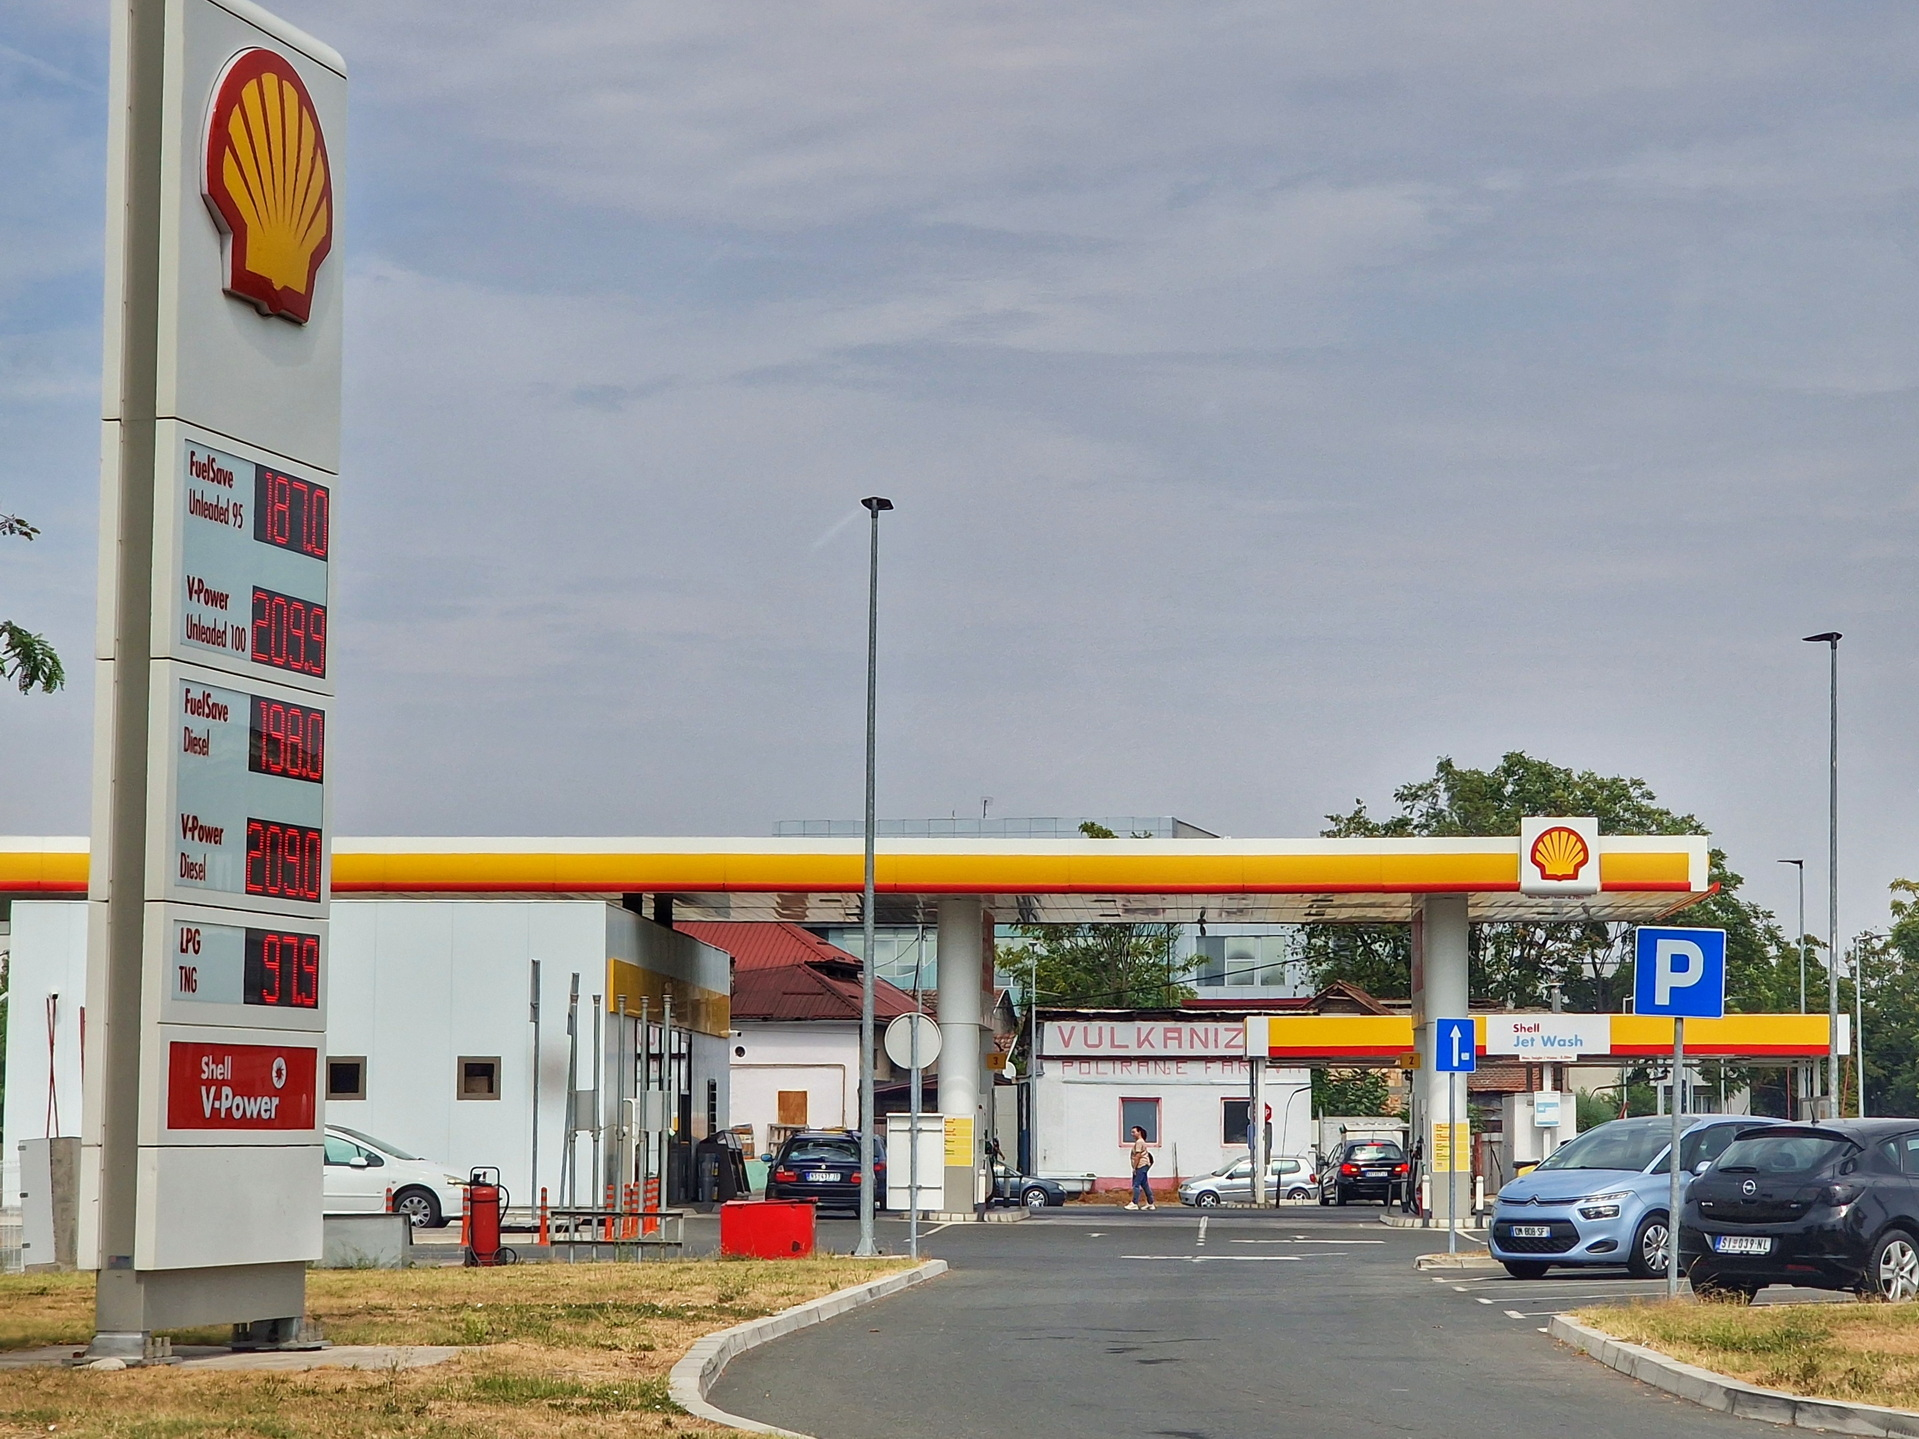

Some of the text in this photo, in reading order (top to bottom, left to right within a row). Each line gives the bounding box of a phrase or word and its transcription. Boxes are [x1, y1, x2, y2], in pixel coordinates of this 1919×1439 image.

[190, 450, 233, 488] FuelSave
[189, 488, 243, 529] Unleaded 95
[265, 472, 327, 556] 187.0
[186, 574, 229, 611] V-Power
[186, 613, 246, 653] Unleaded 100
[252, 591, 325, 674] 209.9
[184, 688, 229, 722] FuelSave
[183, 726, 210, 756] Diesel
[260, 701, 324, 780] 198.0
[181, 813, 224, 846] V-Power
[179, 852, 206, 881] Diesel
[246, 822, 321, 899] 209.0
[179, 927, 201, 955] LPG
[178, 966, 197, 993] TNG
[263, 934, 318, 1006] 97.9
[1654, 938, 1704, 1006] P
[1513, 1023, 1540, 1033] Shell
[1513, 1035, 1583, 1047] Jet Wash
[200, 1056, 232, 1080] Shell
[200, 1085, 280, 1120] V-Power
